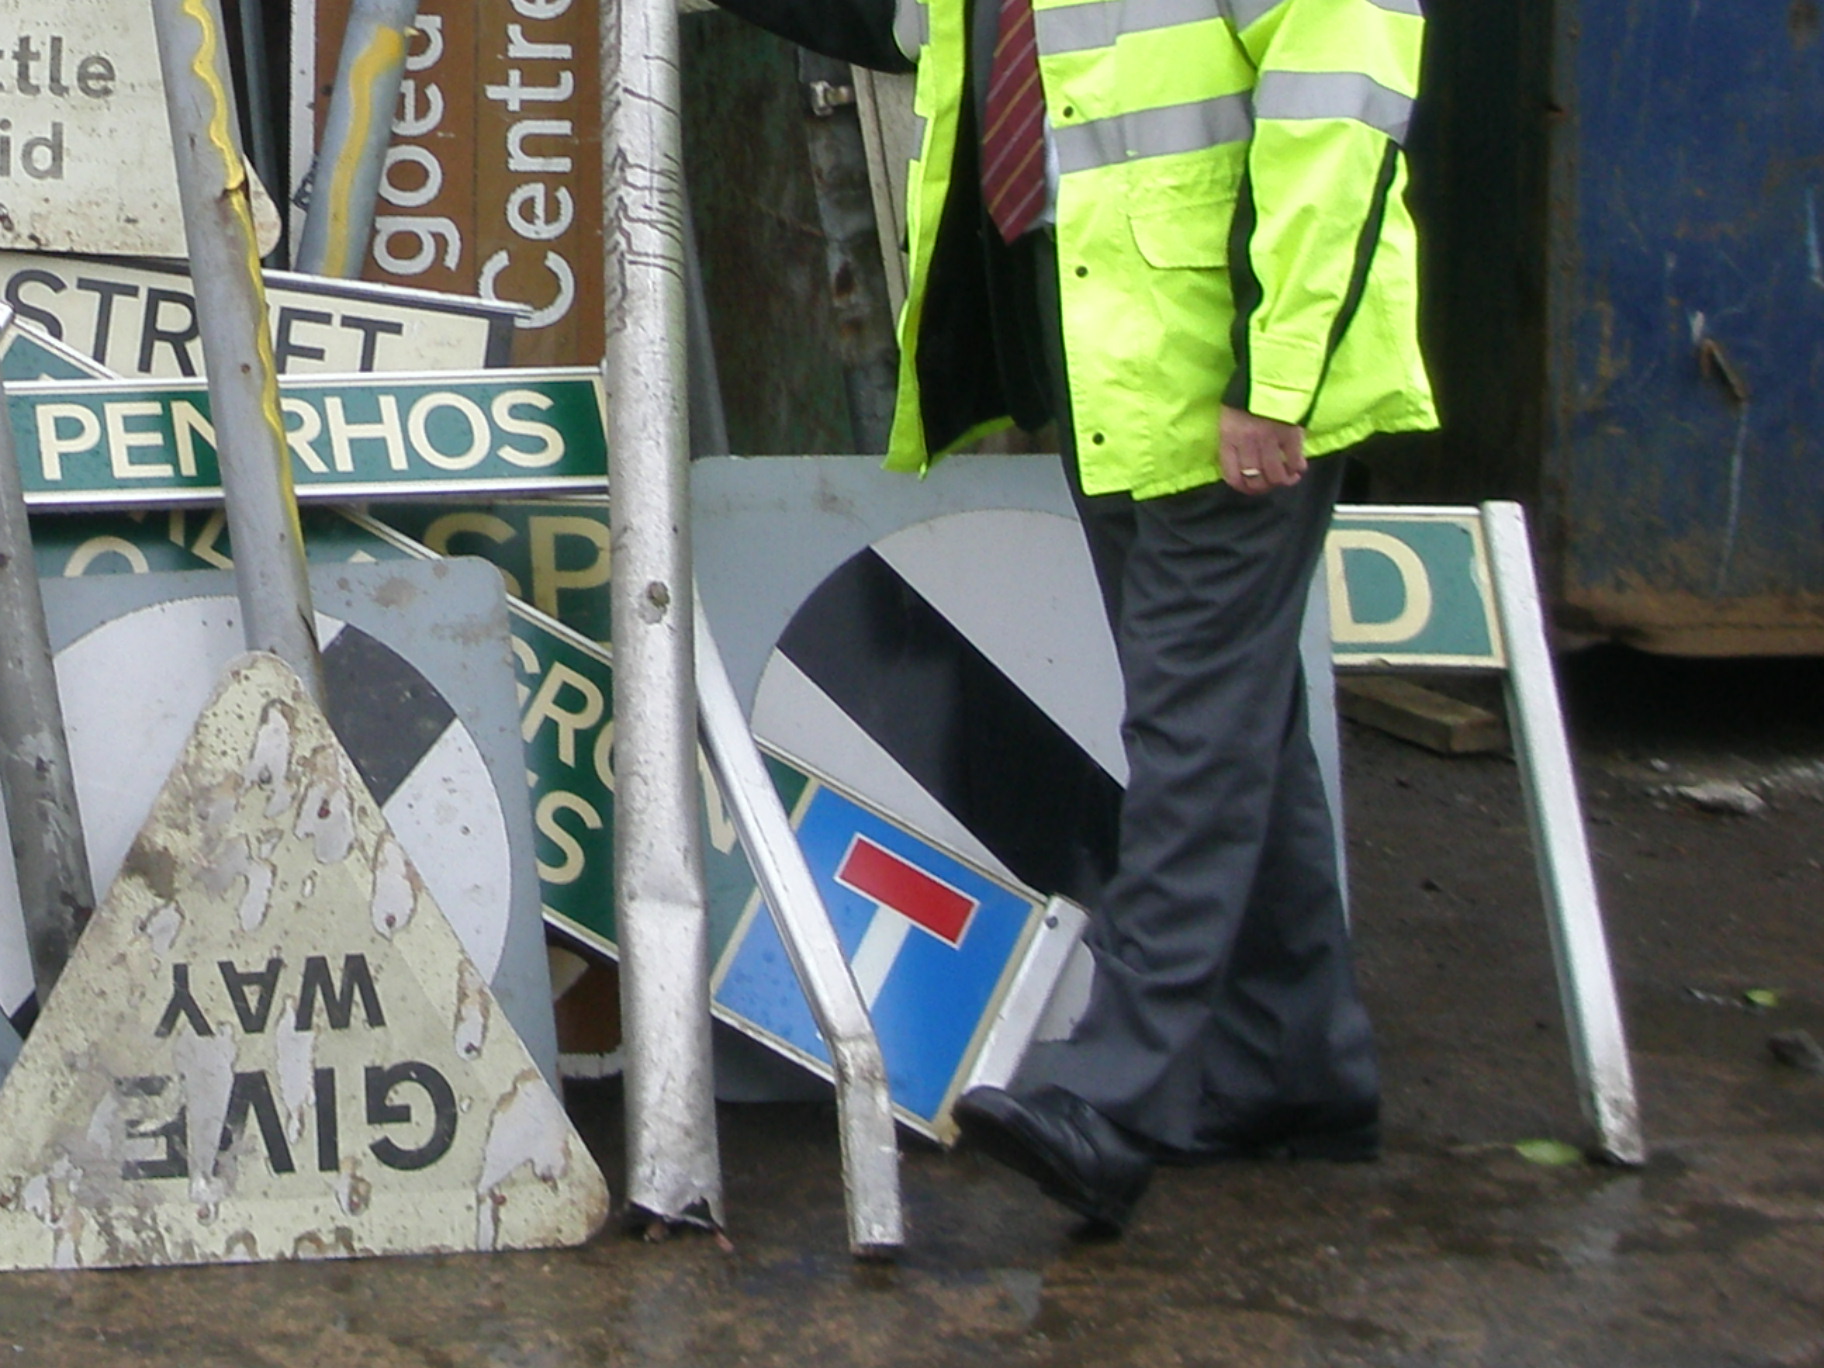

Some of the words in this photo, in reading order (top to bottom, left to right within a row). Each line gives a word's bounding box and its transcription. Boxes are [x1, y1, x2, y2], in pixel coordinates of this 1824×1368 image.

[3, 268, 404, 378] STRET
[34, 388, 565, 482] PENRHOS
[153, 952, 386, 1038] WAY
[117, 1060, 458, 1181] GIVE
